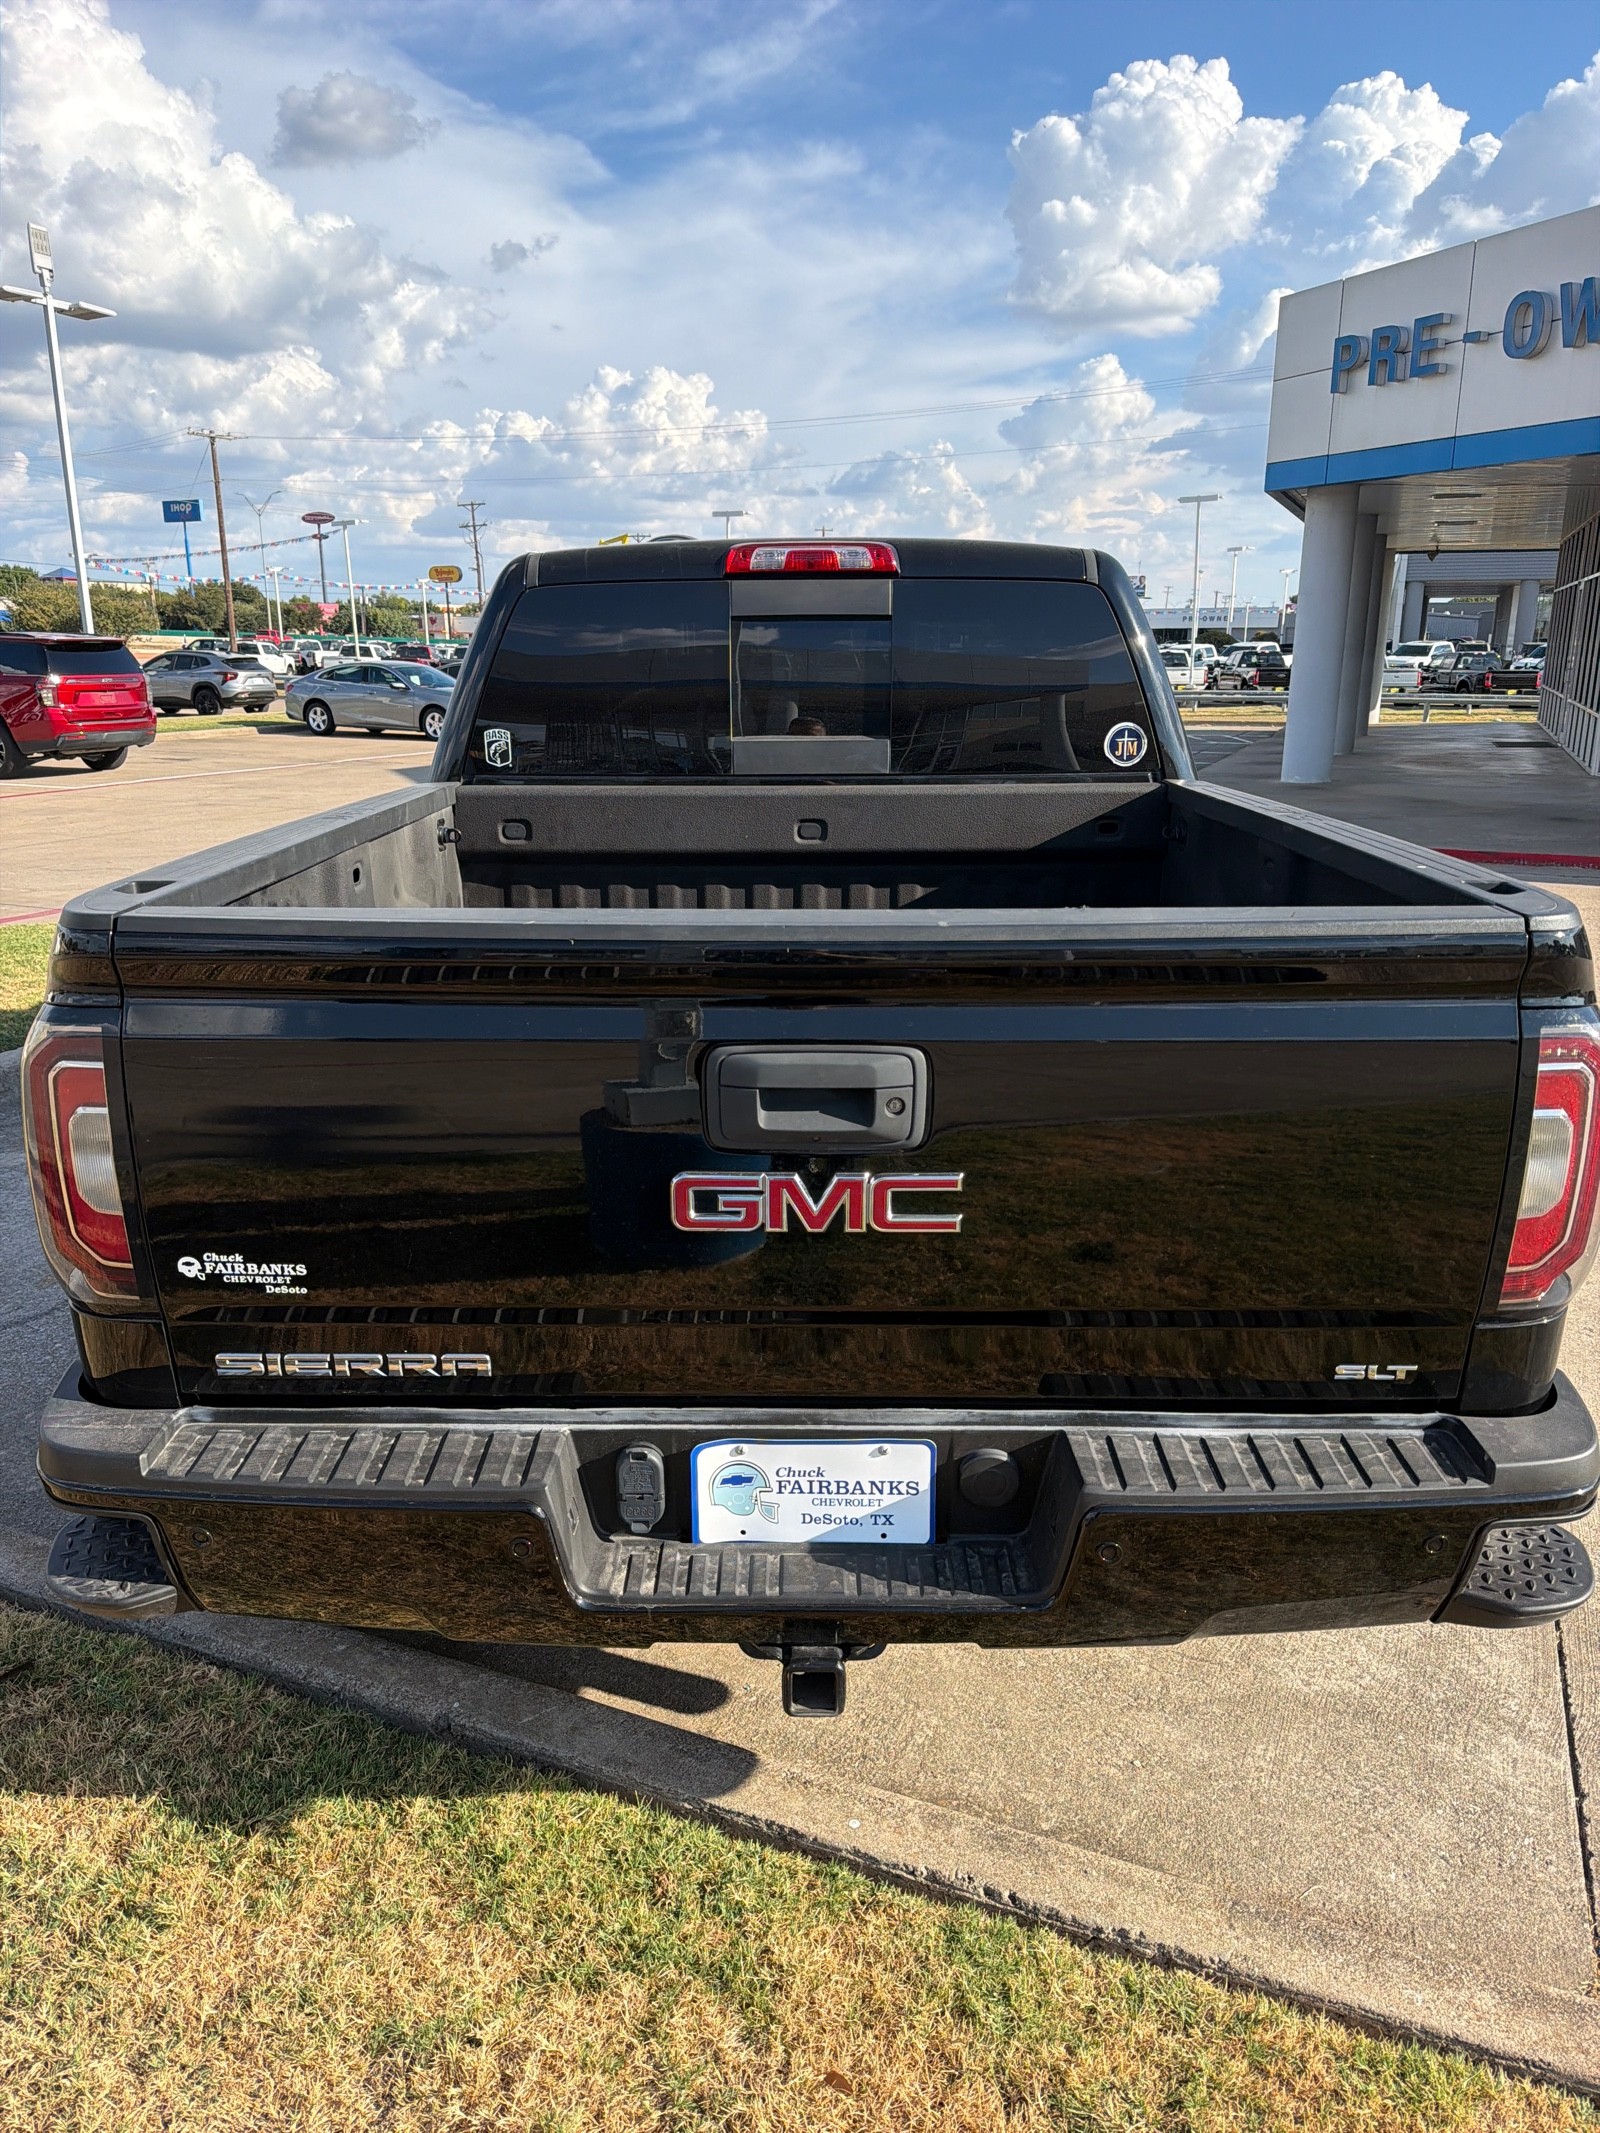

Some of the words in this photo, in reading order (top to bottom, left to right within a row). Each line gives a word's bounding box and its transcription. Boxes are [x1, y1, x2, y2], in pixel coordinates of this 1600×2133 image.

[485, 730, 509, 740] BASS
[670, 1171, 964, 1233] GMC
[203, 1252, 243, 1263] Chuck
[204, 1262, 307, 1276] FAIRBANKS
[223, 1275, 292, 1284] CHEVROLET
[265, 1285, 308, 1294] DeSoto
[214, 1353, 493, 1377] SIERRA
[1334, 1364, 1418, 1380] SLT
[775, 1466, 826, 1479] Chuck
[775, 1480, 920, 1496] FAIRBANKS
[811, 1498, 884, 1508] CHEVROLET
[801, 1513, 863, 1527] DeSoto,
[870, 1514, 895, 1526] TX
